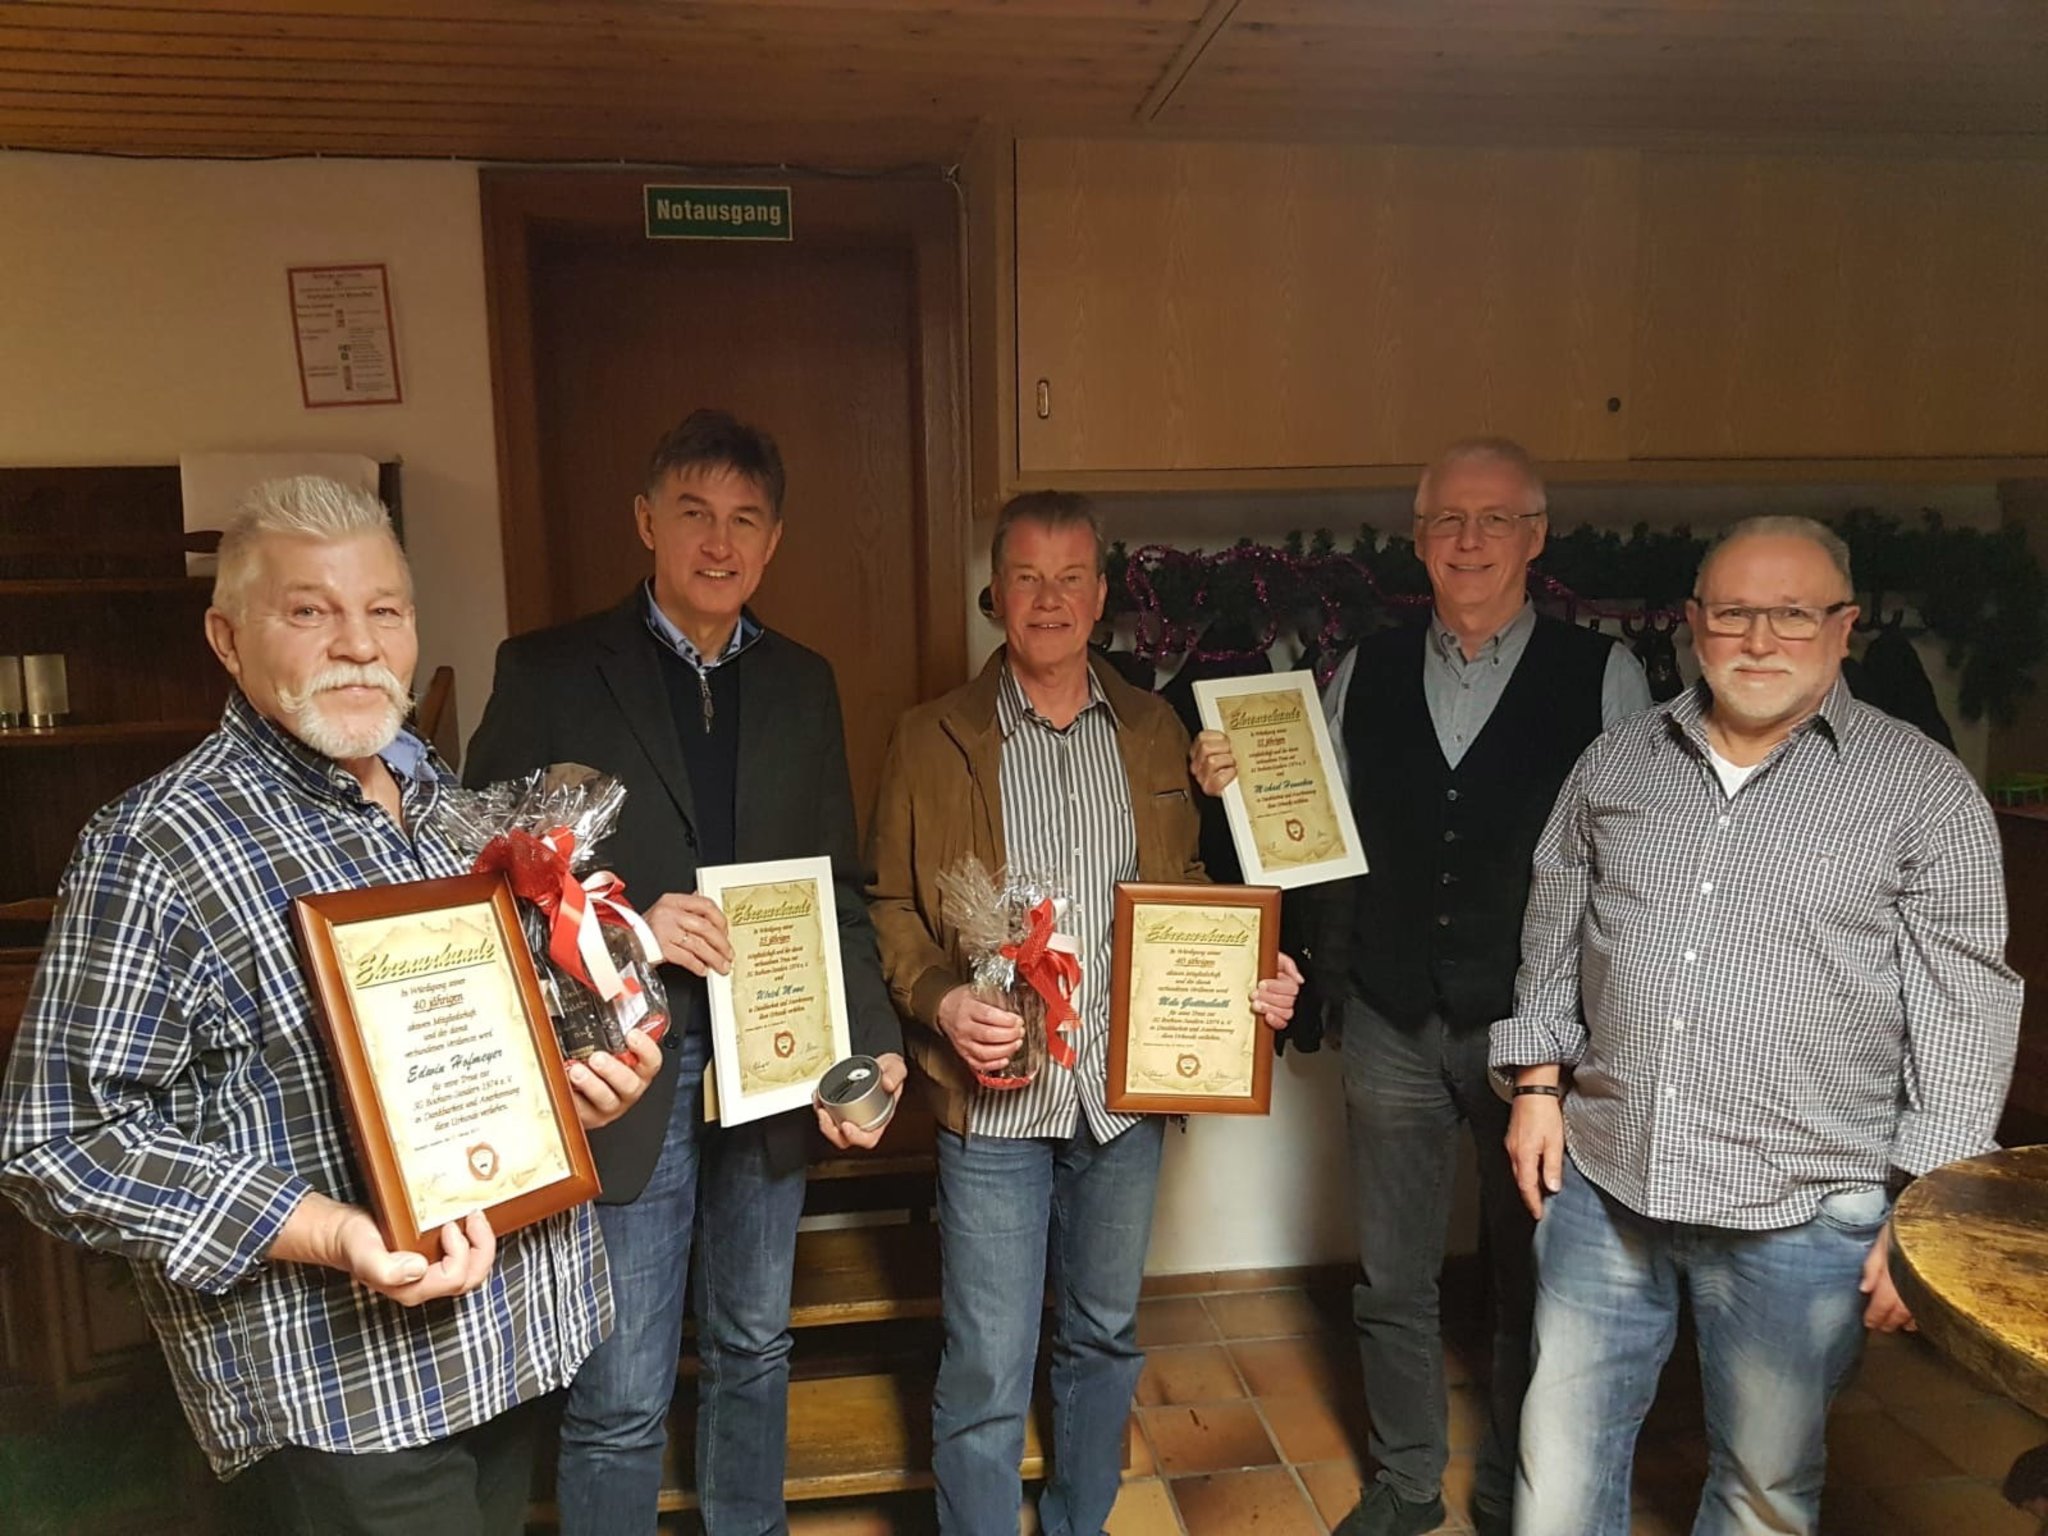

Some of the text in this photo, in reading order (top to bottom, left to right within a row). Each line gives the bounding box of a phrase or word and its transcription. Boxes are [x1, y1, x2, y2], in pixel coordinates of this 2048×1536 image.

[657, 199, 781, 225] Notausgang
[356, 938, 496, 987] Ehrenurkunde
[413, 999, 427, 1012] 40
[406, 1049, 503, 1084] Edwin Hofmeyer
